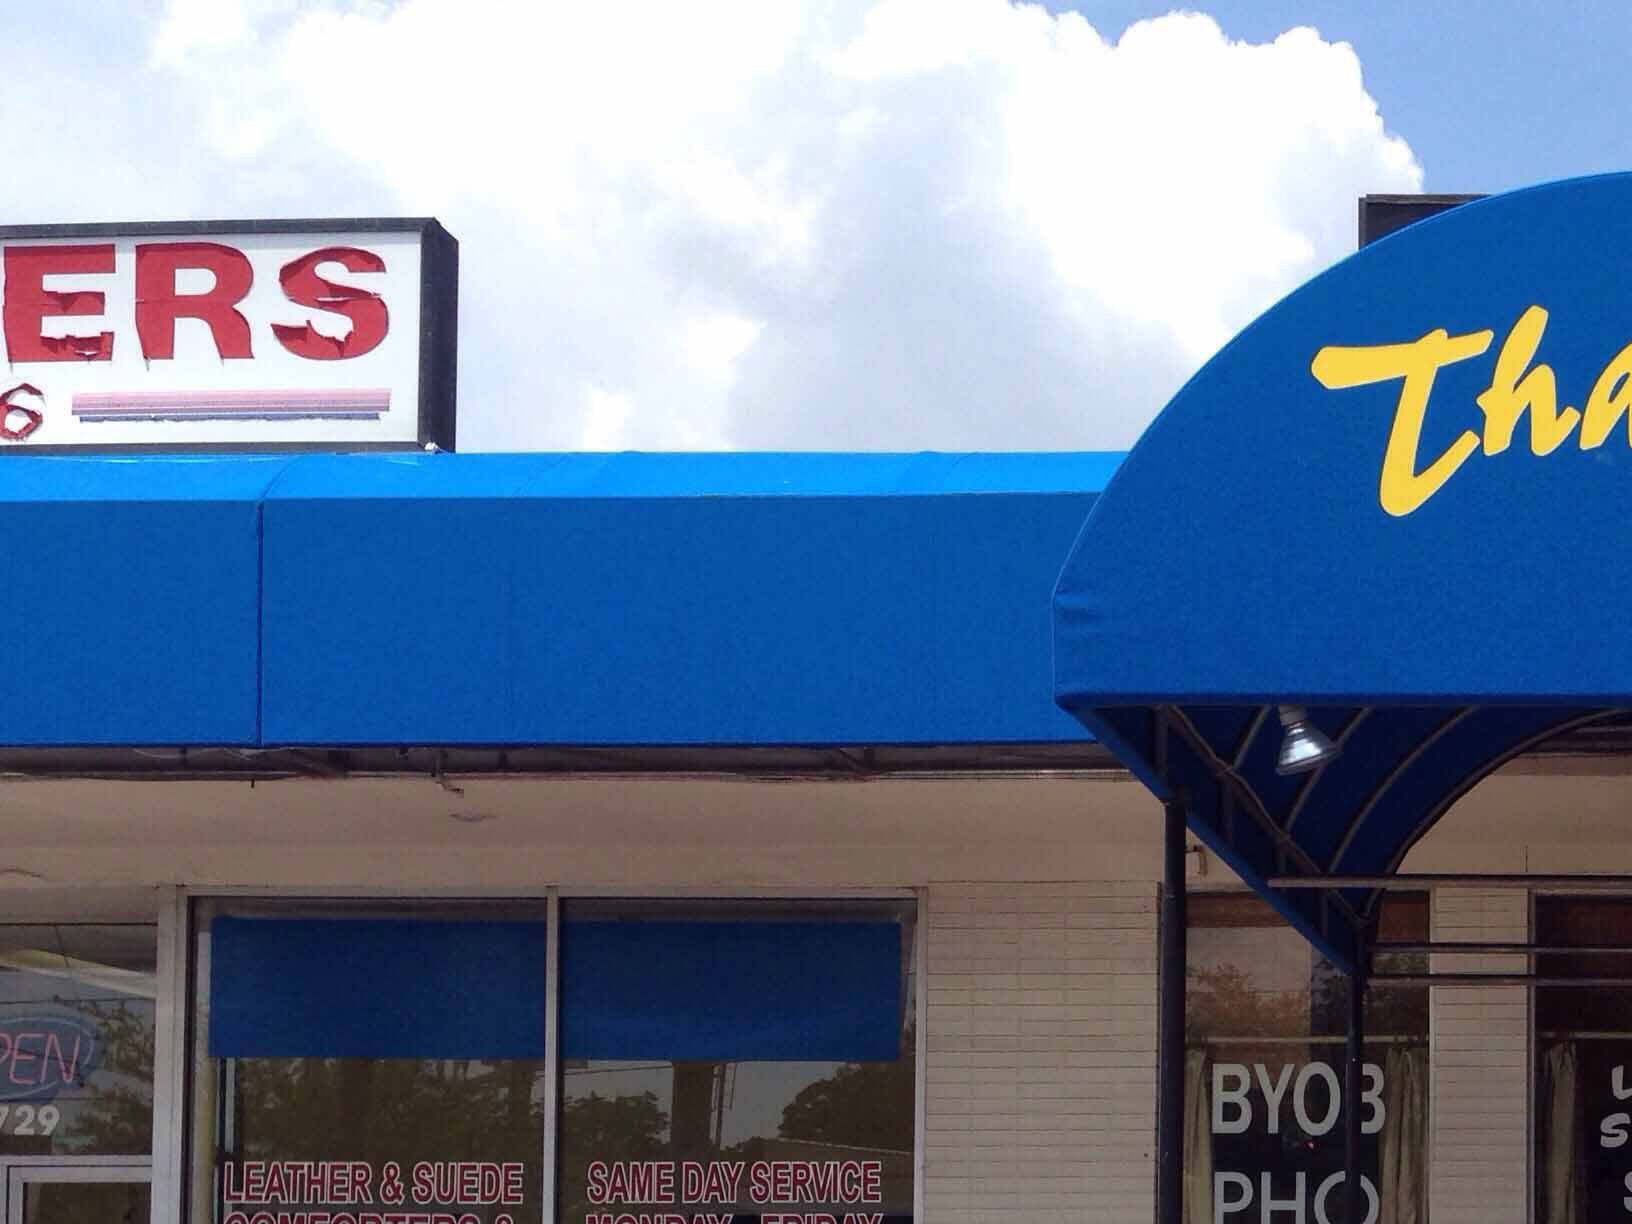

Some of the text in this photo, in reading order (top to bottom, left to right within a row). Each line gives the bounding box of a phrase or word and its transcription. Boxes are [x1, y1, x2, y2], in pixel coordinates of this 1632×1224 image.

[1211, 1061, 1387, 1137] BYOB
[222, 1160, 524, 1205] LEATHER & SUEDE
[586, 1160, 882, 1204] SAME DAY SERVICE
